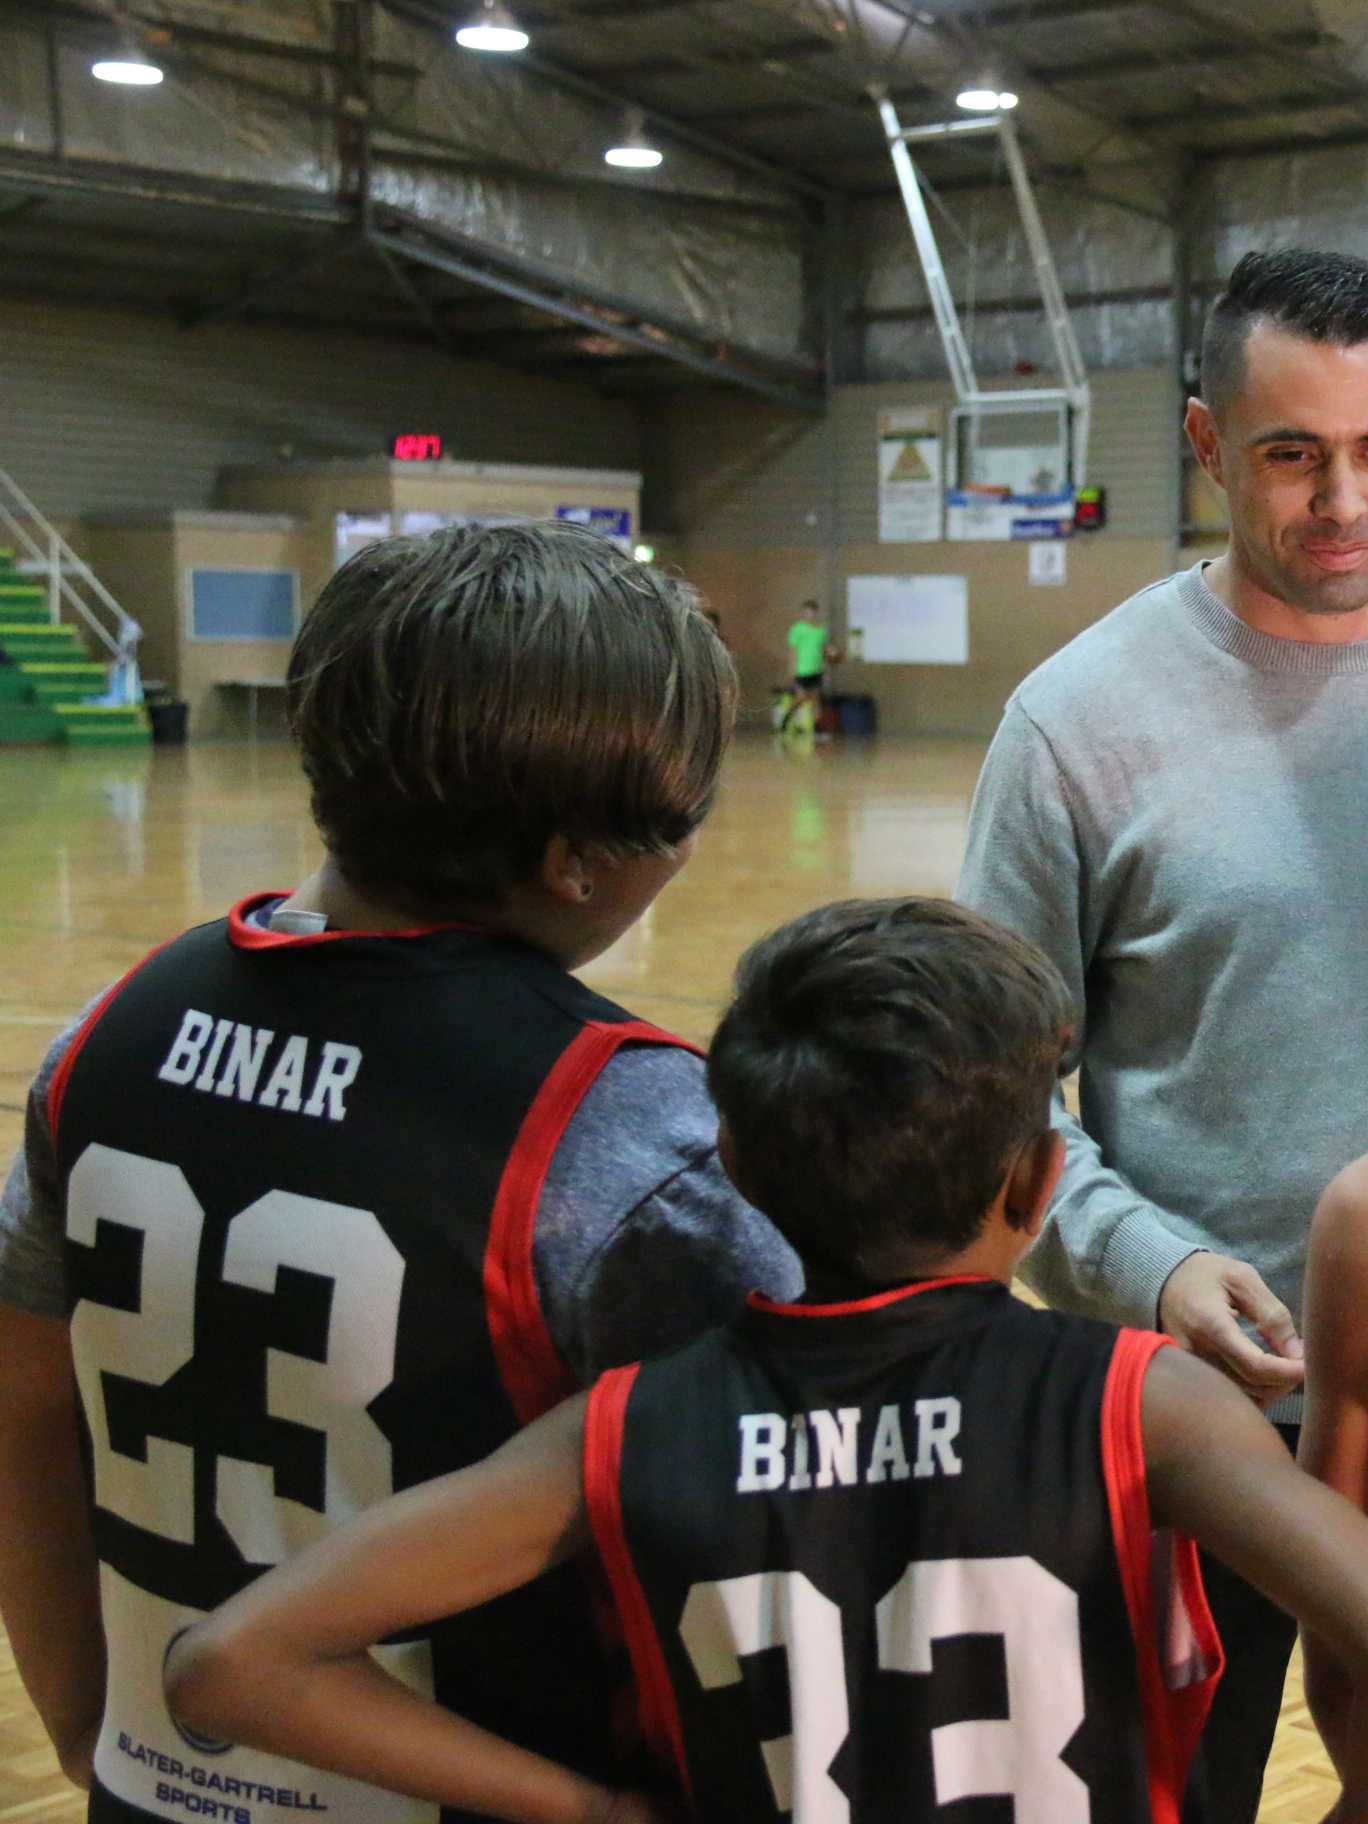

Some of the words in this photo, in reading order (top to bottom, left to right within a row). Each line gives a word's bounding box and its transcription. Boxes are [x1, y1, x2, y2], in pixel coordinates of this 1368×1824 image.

[158, 1008, 362, 1122] BINAR
[65, 1142, 406, 1566] 23
[736, 1396, 962, 1494] BINAR
[678, 1555, 1092, 1824] 33
[117, 1731, 328, 1812] SLATER-GARTRELL
[155, 1782, 251, 1824] SPORTS
